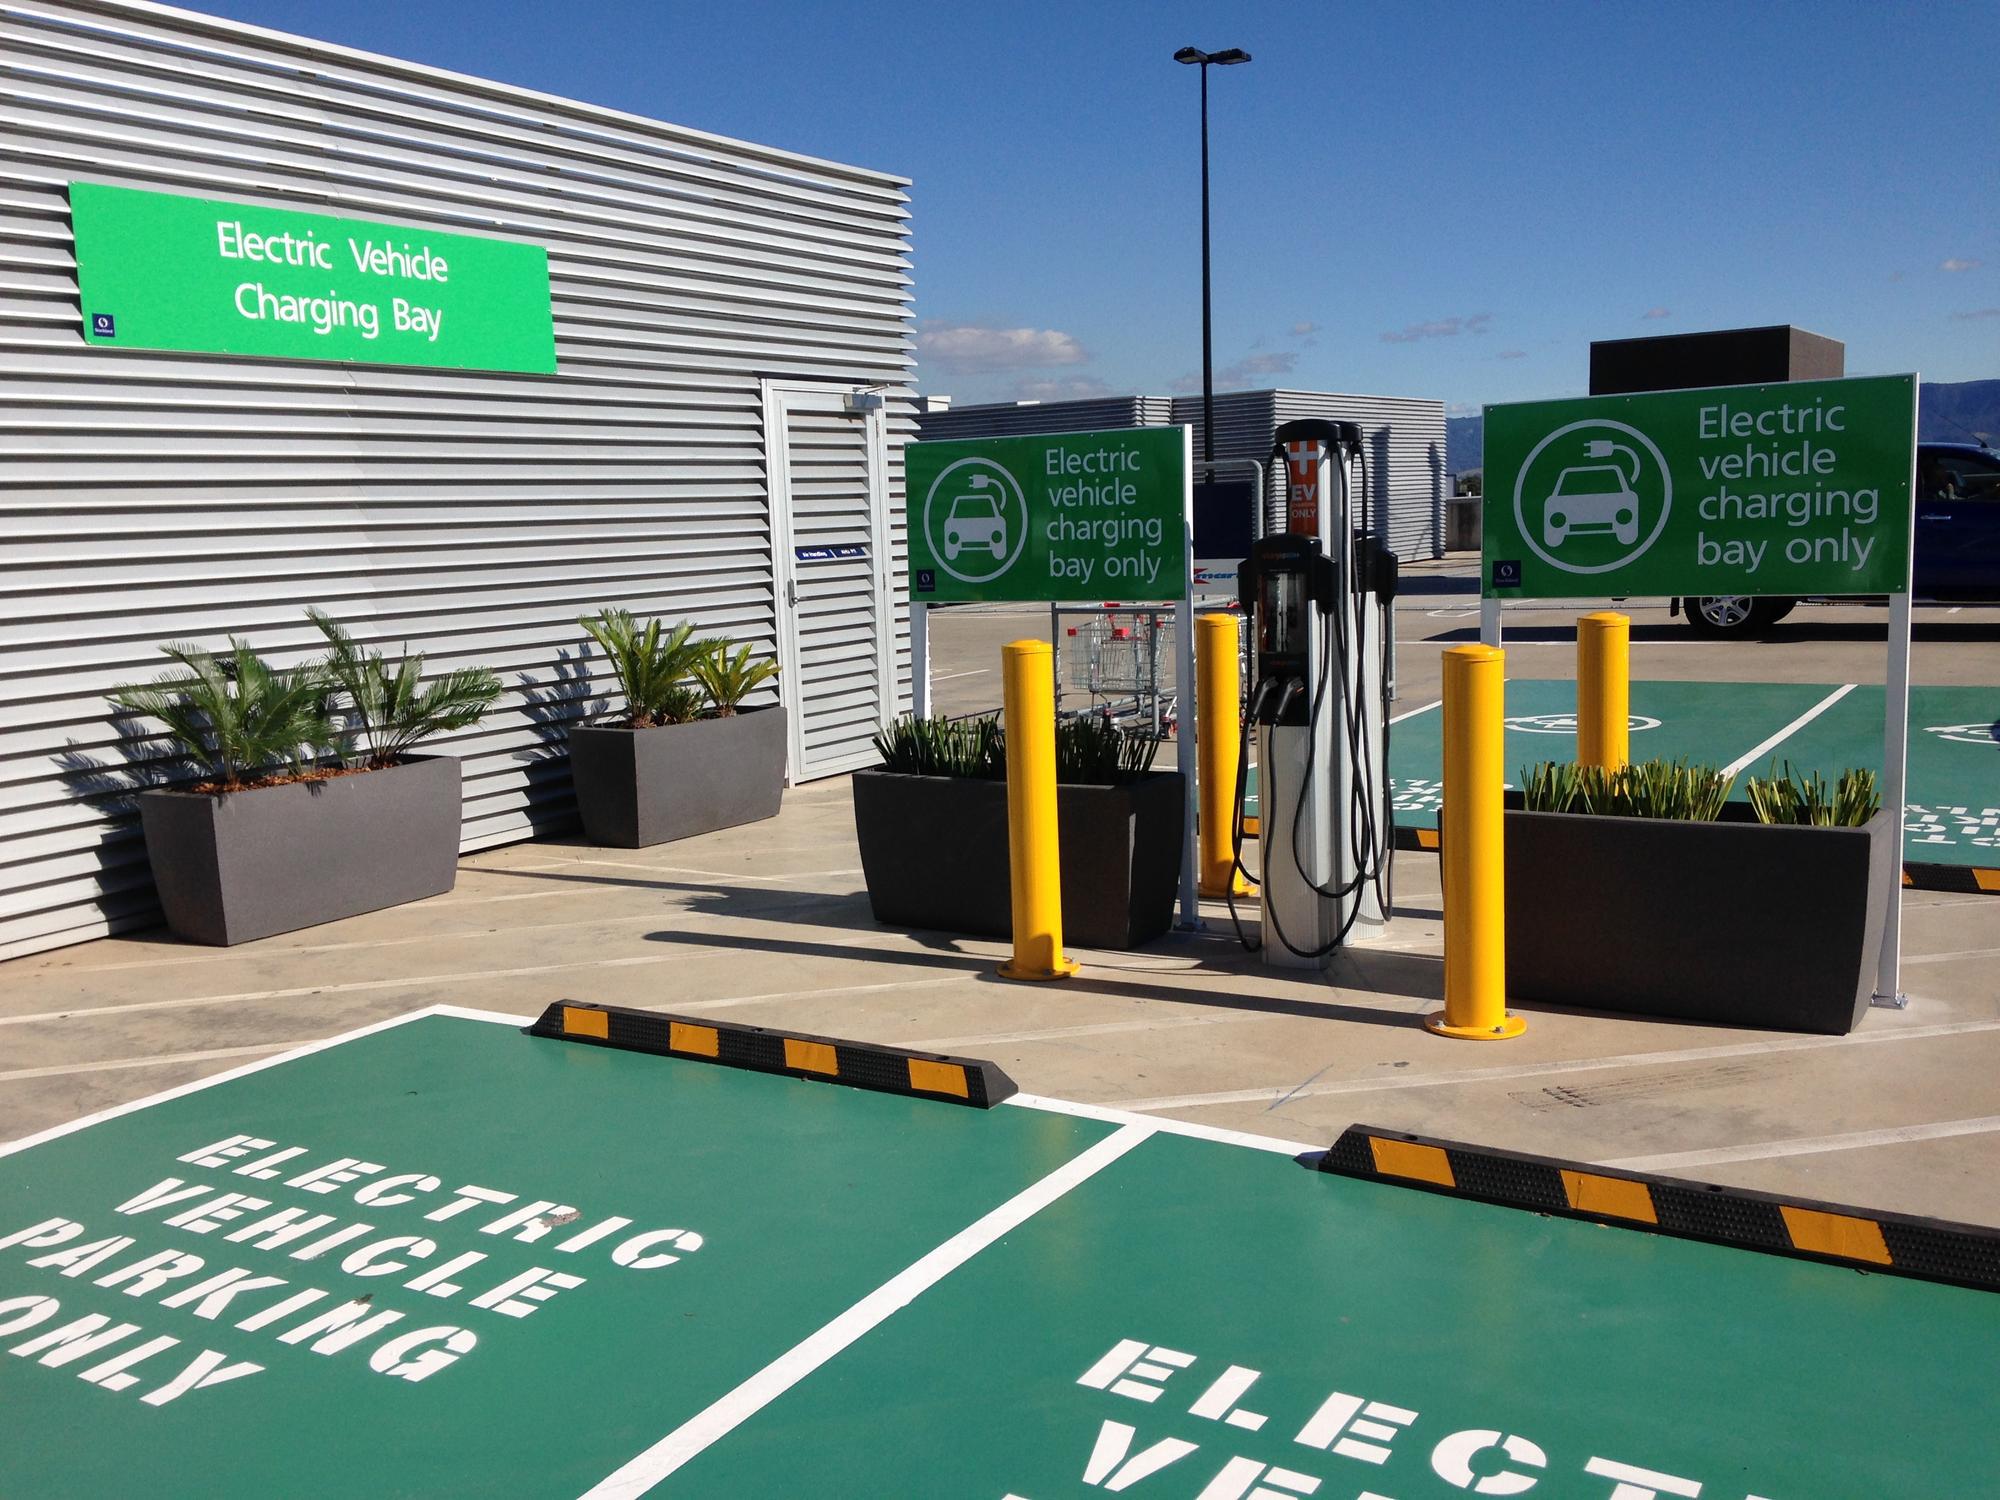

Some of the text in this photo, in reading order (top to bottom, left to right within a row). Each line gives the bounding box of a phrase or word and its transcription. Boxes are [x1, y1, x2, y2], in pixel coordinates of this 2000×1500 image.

[216, 221, 449, 283] Electric Vehicle
[234, 282, 442, 343] Charging Bay
[1699, 397, 1845, 439] Electric
[1045, 443, 1141, 475] Electric
[1699, 440, 1836, 480] vehicle
[1048, 477, 1137, 507] vehicle
[1291, 484, 1317, 501] EV
[1291, 507, 1317, 518] ONLY
[1699, 481, 1879, 527] charging
[1046, 511, 1162, 547] charging
[1697, 527, 1875, 573] bay only
[1049, 549, 1161, 585] bay only
[175, 1134, 704, 1270] ELECTRIC
[113, 1177, 587, 1319] VEHICLE
[0, 1216, 478, 1383] PARKING
[0, 1295, 266, 1407] ONLY
[1076, 1338, 1773, 1500] ELECT
